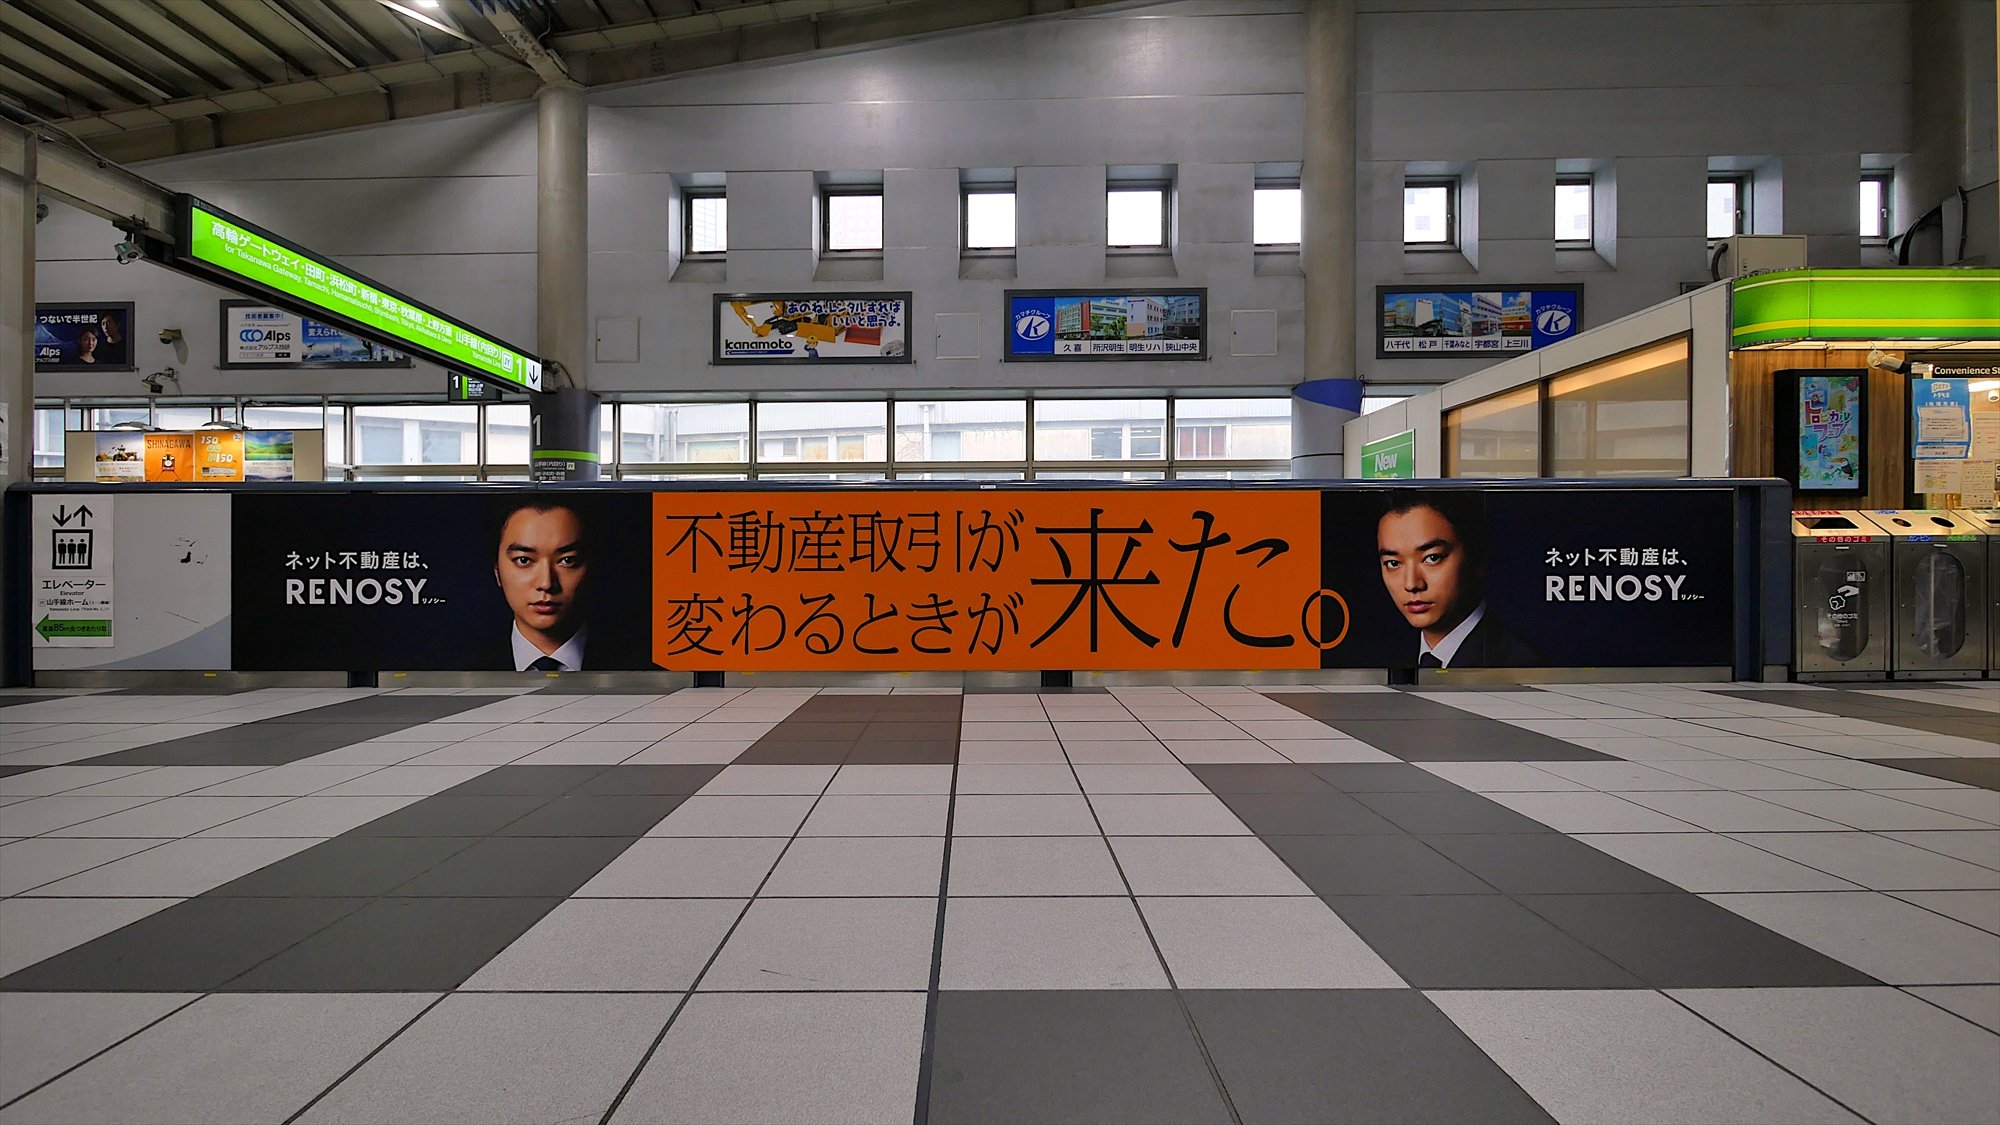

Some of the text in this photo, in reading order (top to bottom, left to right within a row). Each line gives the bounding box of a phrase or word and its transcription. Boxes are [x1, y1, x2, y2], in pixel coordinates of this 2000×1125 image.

[224, 243, 235, 254] for
[237, 248, 272, 270] Takanawa
[272, 264, 303, 284] Gateway,
[1015, 309, 1051, 320] カマチグループ
[1535, 304, 1572, 315] カマチグループ
[832, 315, 901, 327] いいと思うよ。
[264, 330, 291, 343] Alps
[725, 339, 793, 350] kanamoto
[1092, 342, 1125, 352] 所沢明生
[1129, 342, 1162, 352] 明生リハ
[1165, 342, 1198, 352] 狭山中央
[1386, 341, 1411, 349] 八千代
[1474, 340, 1499, 349] 宇都宮
[1504, 339, 1529, 348] 上三川
[40, 347, 61, 357] Alps
[516, 357, 522, 382] 1
[1934, 366, 1990, 375] Convenience
[453, 375, 459, 389] 1
[532, 414, 541, 446] 1
[147, 439, 191, 449] SHINAGAWA
[1374, 453, 1398, 472] New
[665, 509, 1022, 574] 不動産取引が
[285, 551, 429, 570] ネット不動産は、
[1545, 547, 1688, 566] ネット不動産は、
[42, 580, 106, 590] エレベーター
[1029, 508, 1350, 653] 来た。
[286, 578, 427, 605] RENOSY
[1546, 574, 1686, 601] RENOSY
[665, 592, 1023, 656] 変わるときが
